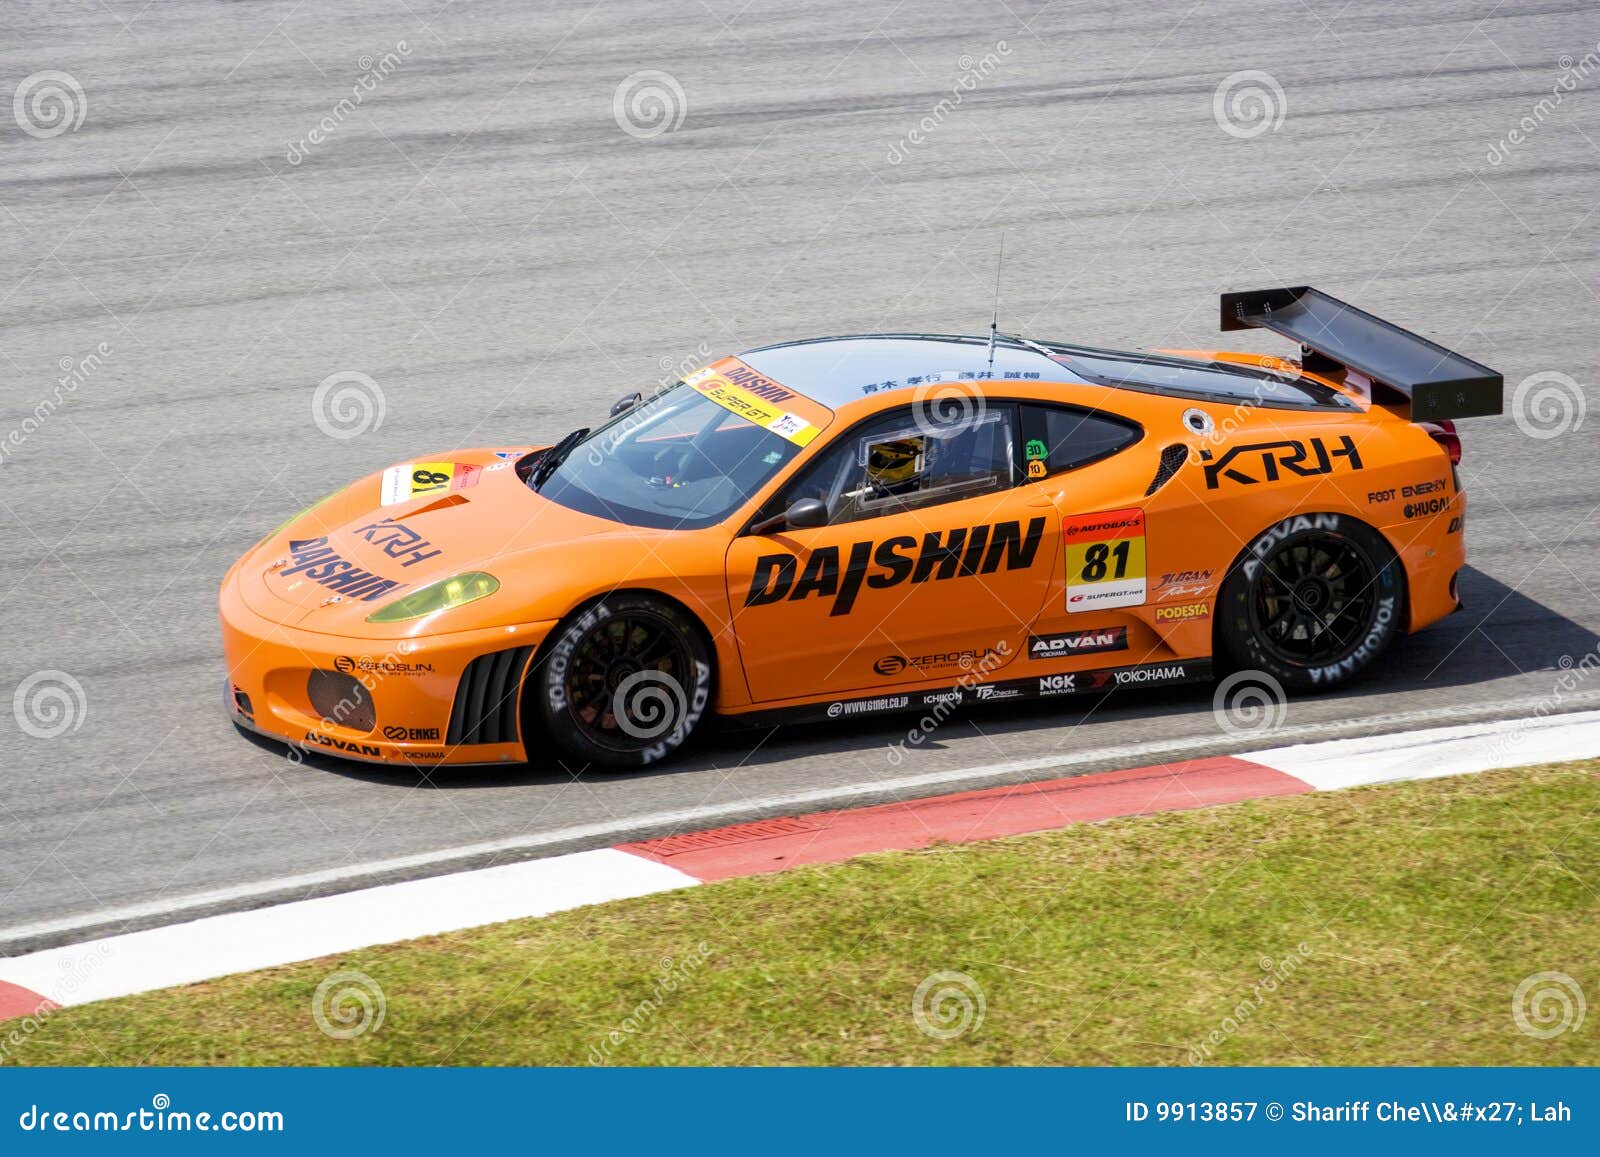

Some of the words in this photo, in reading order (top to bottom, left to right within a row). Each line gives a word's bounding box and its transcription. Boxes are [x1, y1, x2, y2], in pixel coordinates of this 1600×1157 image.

[724, 367, 797, 403] DAISHIN
[1027, 445, 1042, 456] 30
[1201, 435, 1364, 490] KRH
[412, 469, 450, 493] 81
[1030, 464, 1041, 474] 10
[1368, 488, 1396, 504] FOOT
[1401, 479, 1446, 498] ENERGY
[1080, 519, 1141, 533] AUTOBACS
[353, 518, 443, 567] KRH
[1243, 514, 1338, 581] ADVAN
[280, 536, 410, 602] DAISHIN
[743, 516, 1047, 617] DAISHIN
[1081, 540, 1130, 583] 81
[1156, 603, 1209, 620] PODESTA
[1032, 634, 1114, 652] ADVAN
[1308, 597, 1394, 683] YOKOHAMA
[1039, 674, 1076, 691] NGK
[1113, 666, 1186, 684] YOKOHAMA
[642, 660, 710, 765] ADVAN
[305, 729, 380, 756] ADVAN
[409, 728, 440, 740] ENKEI
